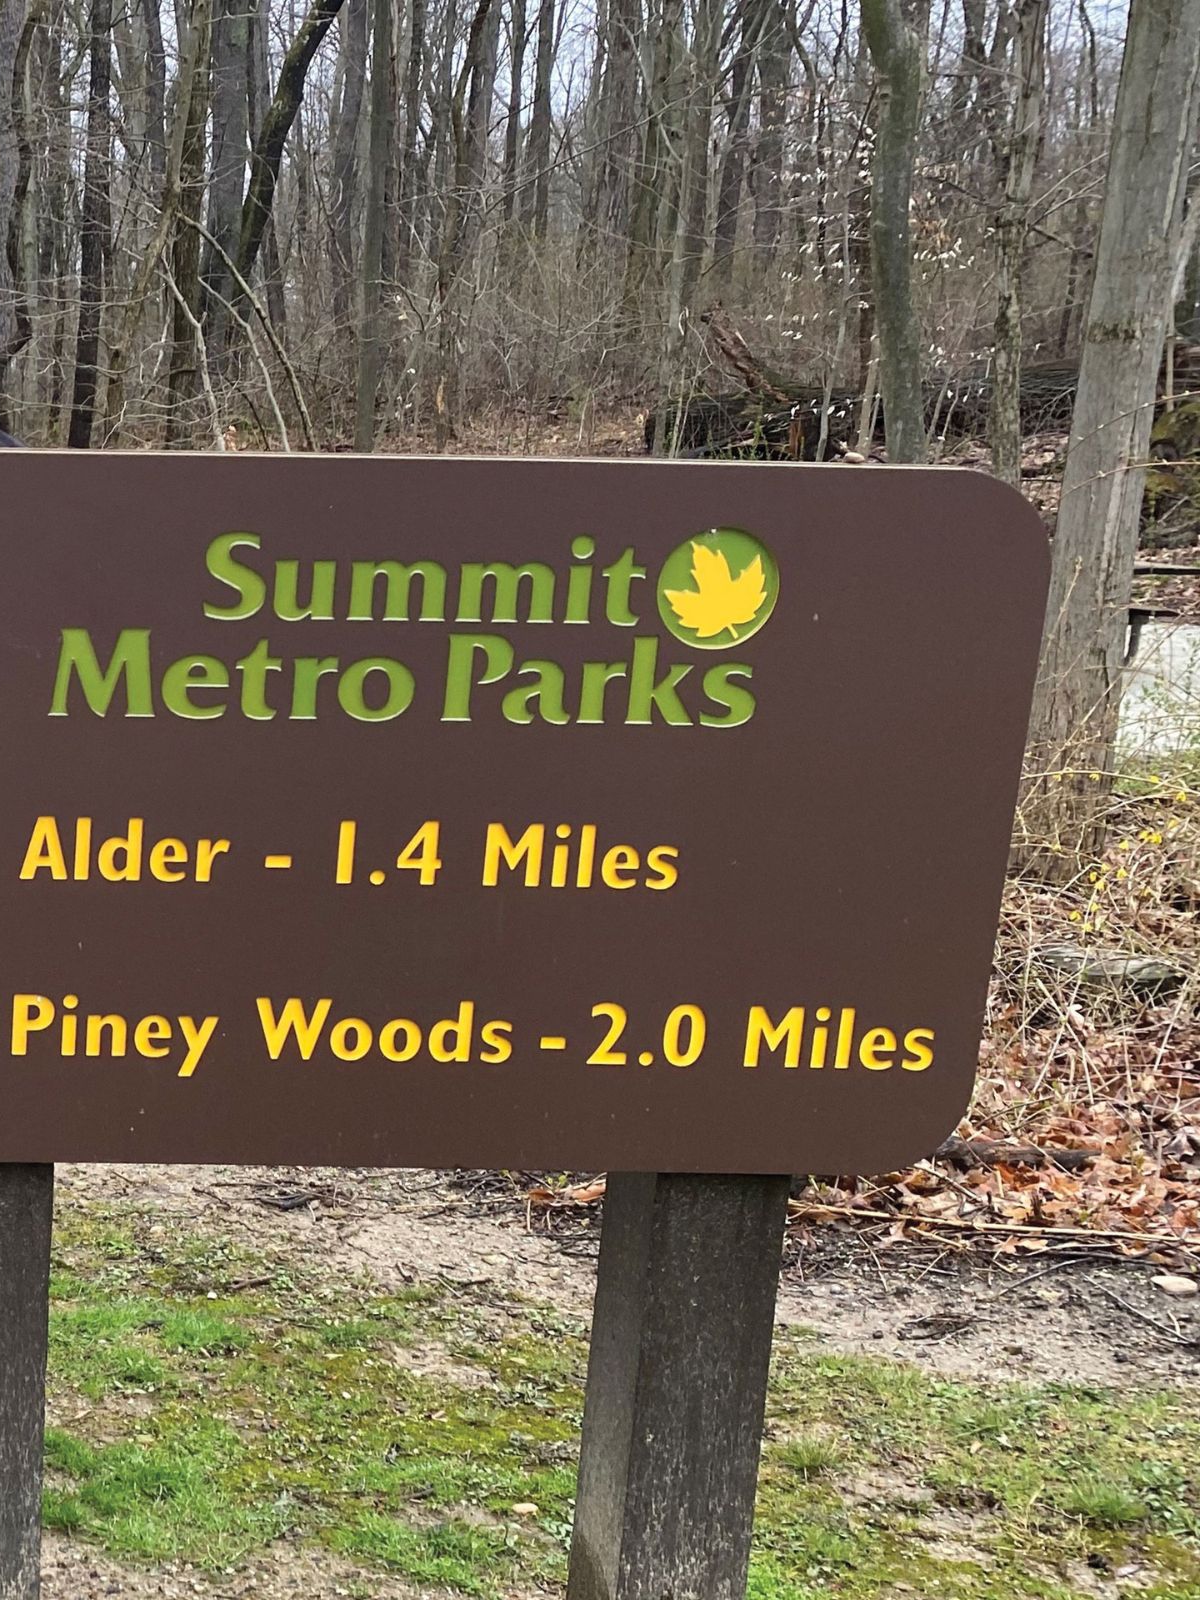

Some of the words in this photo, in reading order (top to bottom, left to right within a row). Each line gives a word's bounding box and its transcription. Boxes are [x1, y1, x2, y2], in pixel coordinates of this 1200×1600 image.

[202, 531, 647, 627] Summit
[47, 627, 416, 723] Metro
[440, 633, 758, 728] Parks
[18, 814, 232, 884] Alder
[334, 818, 444, 887] 1.4
[480, 820, 681, 892] Miles
[9, 992, 220, 1079] Piney
[254, 995, 514, 1065] Woods
[585, 1000, 708, 1069] 2.0
[741, 1003, 937, 1073] Miles
